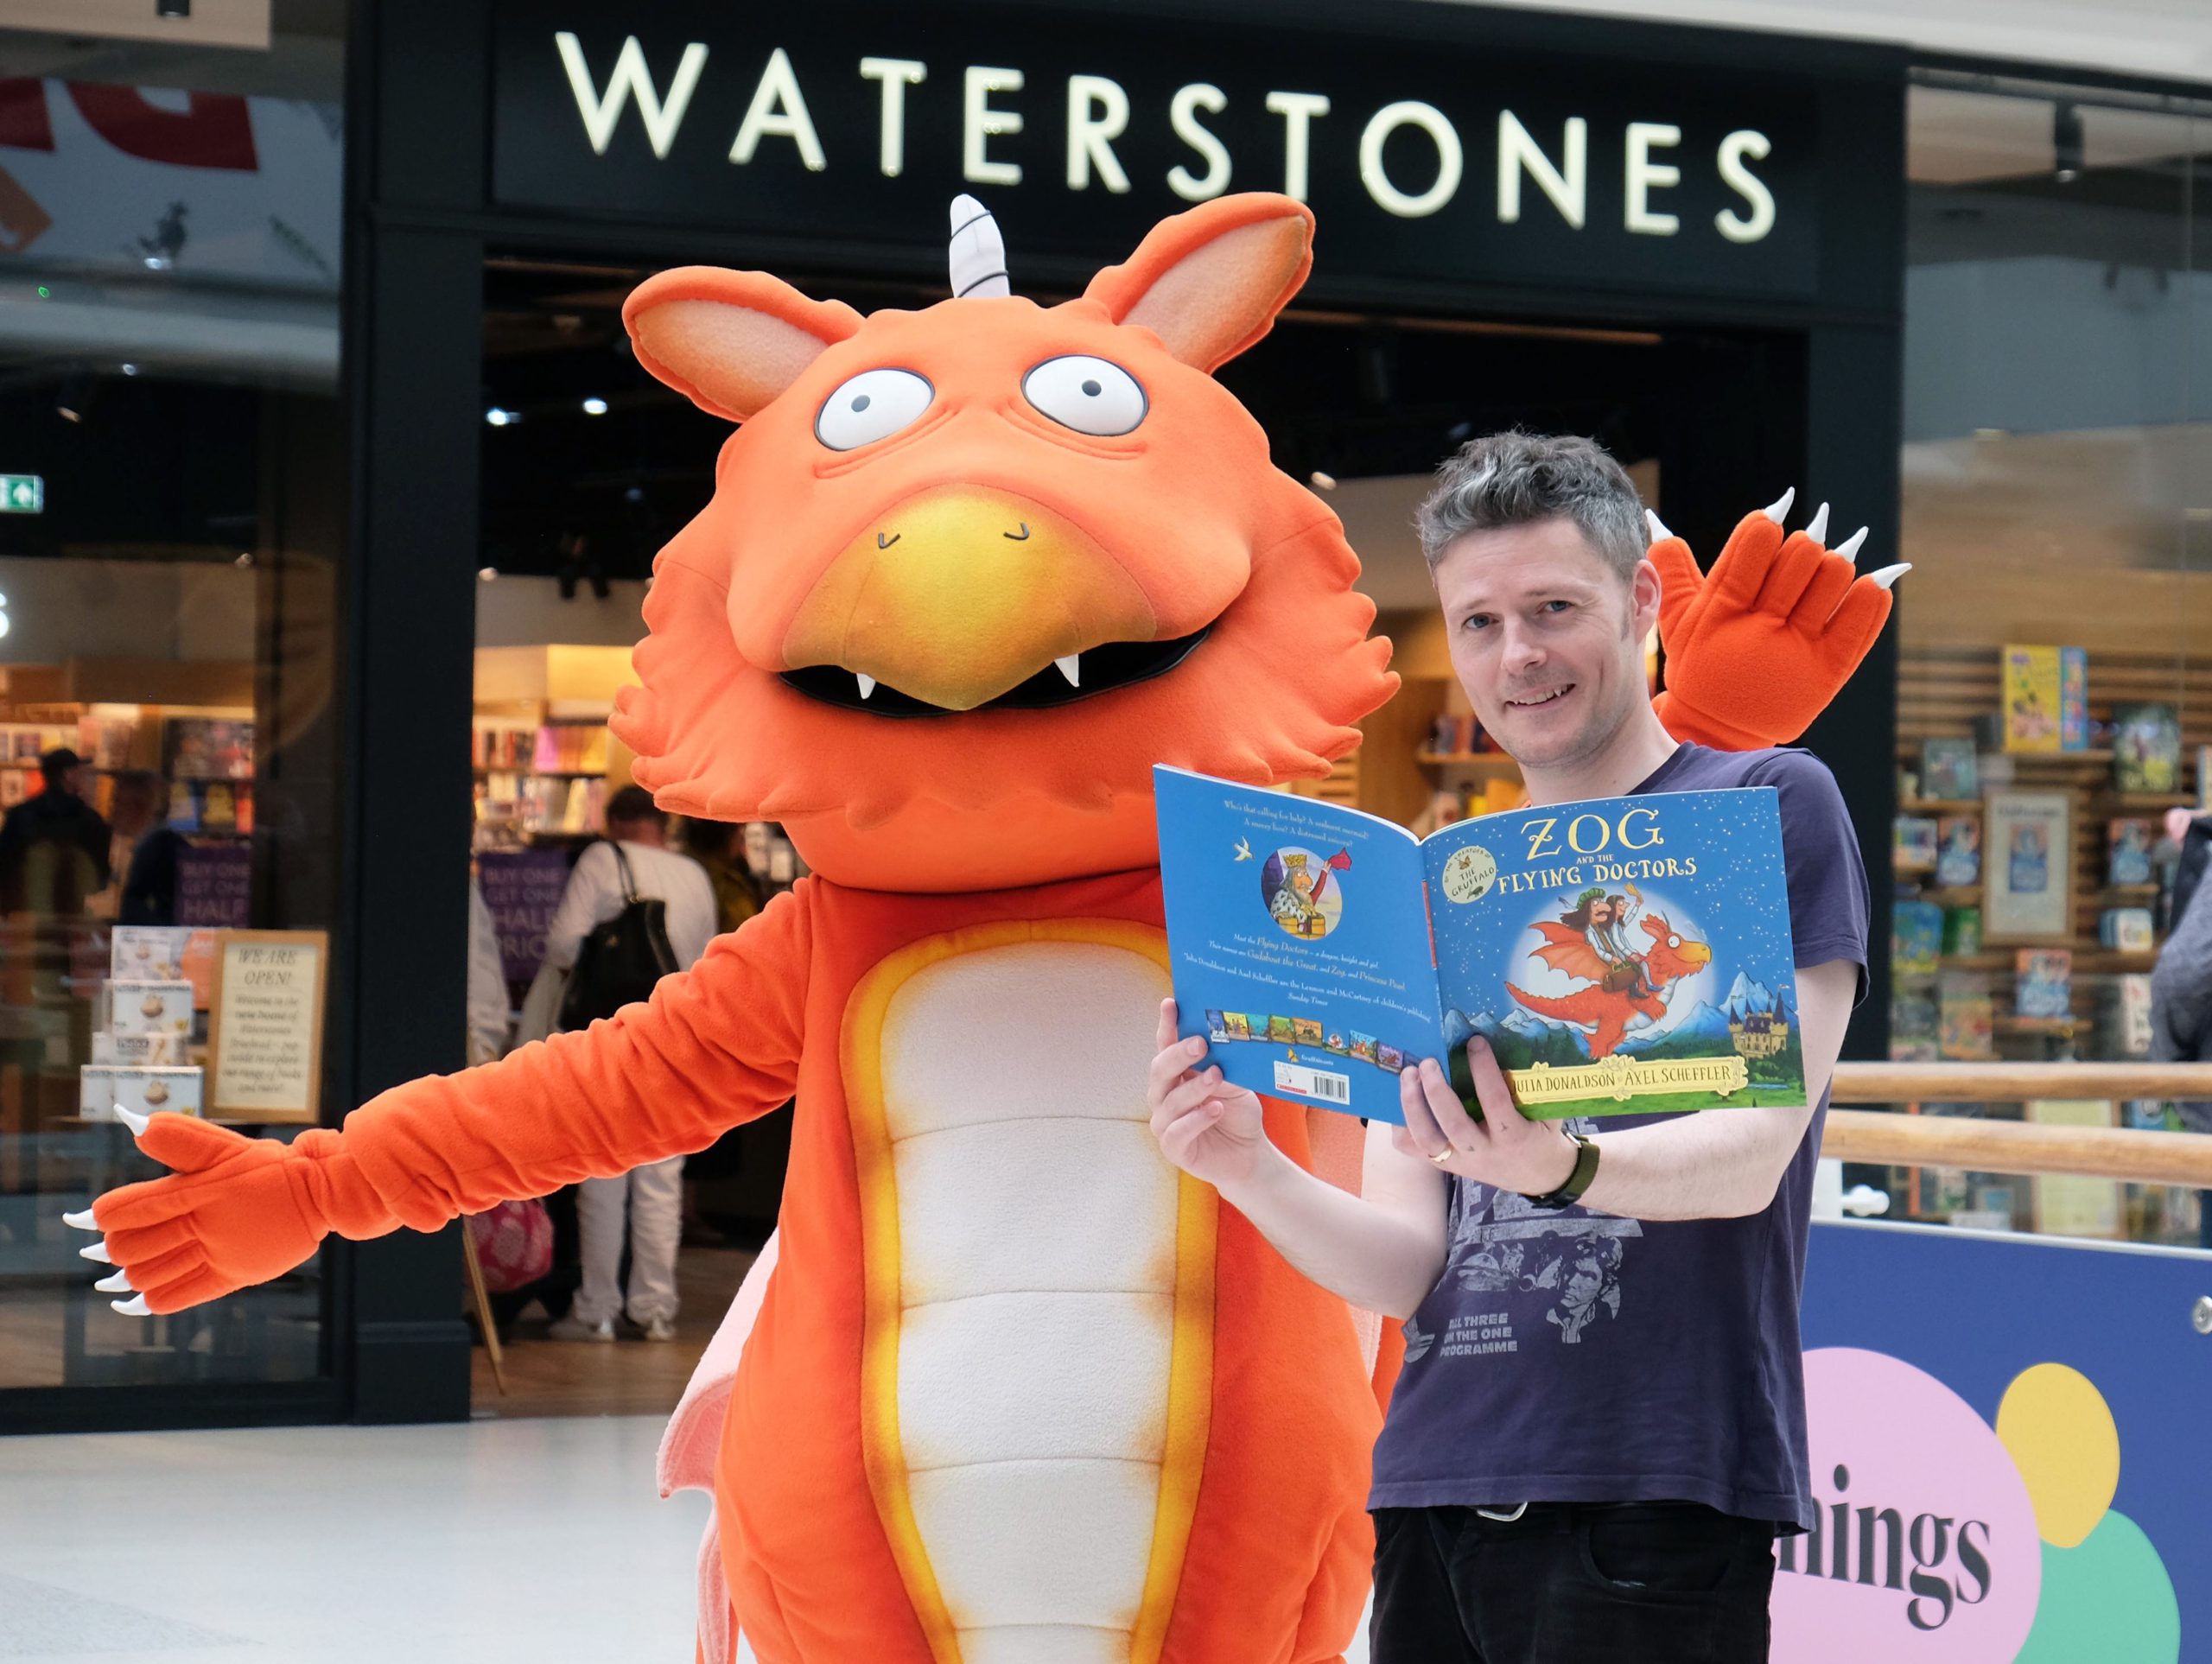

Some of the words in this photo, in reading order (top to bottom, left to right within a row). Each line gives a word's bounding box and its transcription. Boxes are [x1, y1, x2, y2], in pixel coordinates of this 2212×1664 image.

[555, 31, 1777, 244] WATERSTONES
[1520, 809, 1665, 861] ZOG
[1576, 854, 1595, 865] AND
[1598, 854, 1614, 863] THE
[1497, 866, 1583, 895] FLYING
[1592, 856, 1698, 883] DOCTORS
[264, 949, 297, 964] ARE
[1282, 956, 1294, 967] the
[1545, 1071, 1615, 1091] DONALDSON
[1624, 1070, 1659, 1086] AXEL
[1661, 1065, 1732, 1083] SCHEFFLER
[1448, 1317, 1462, 1330] ALL
[1464, 1312, 1509, 1328] THREE
[1456, 1330, 1478, 1342] THE
[1480, 1326, 1512, 1340] ONE
[1440, 1340, 1518, 1358] PROGRAMME
